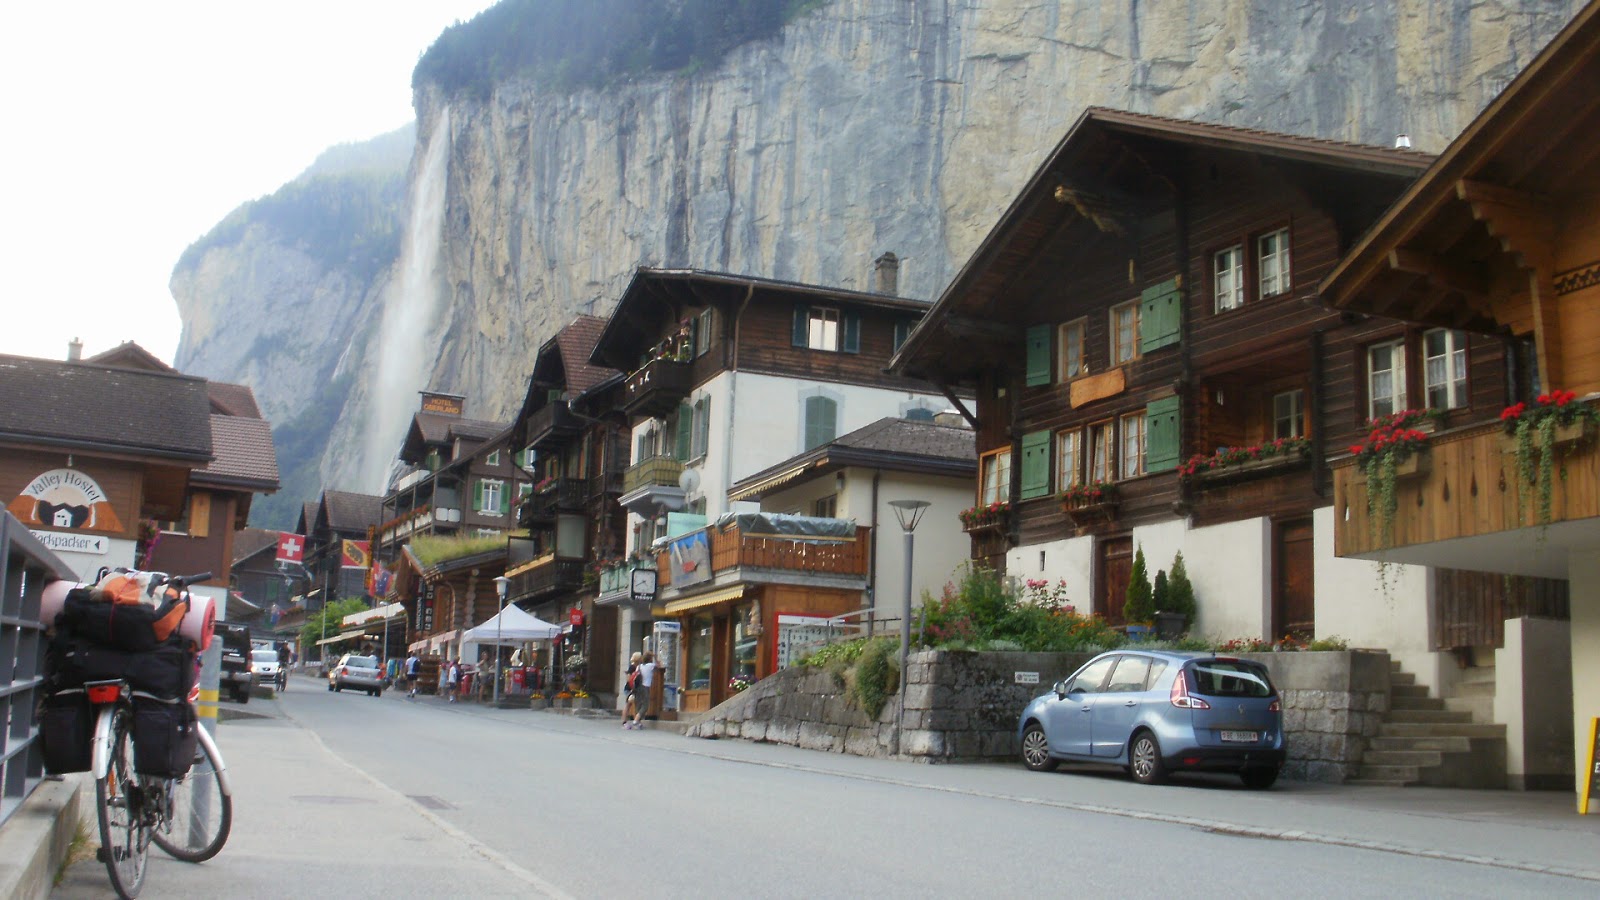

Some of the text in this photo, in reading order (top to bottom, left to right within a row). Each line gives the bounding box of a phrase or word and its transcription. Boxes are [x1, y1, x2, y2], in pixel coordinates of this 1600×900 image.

[431, 398, 453, 406] HOTEL
[424, 403, 459, 413] OBERLAND
[29, 472, 100, 501] Valley Hostel
